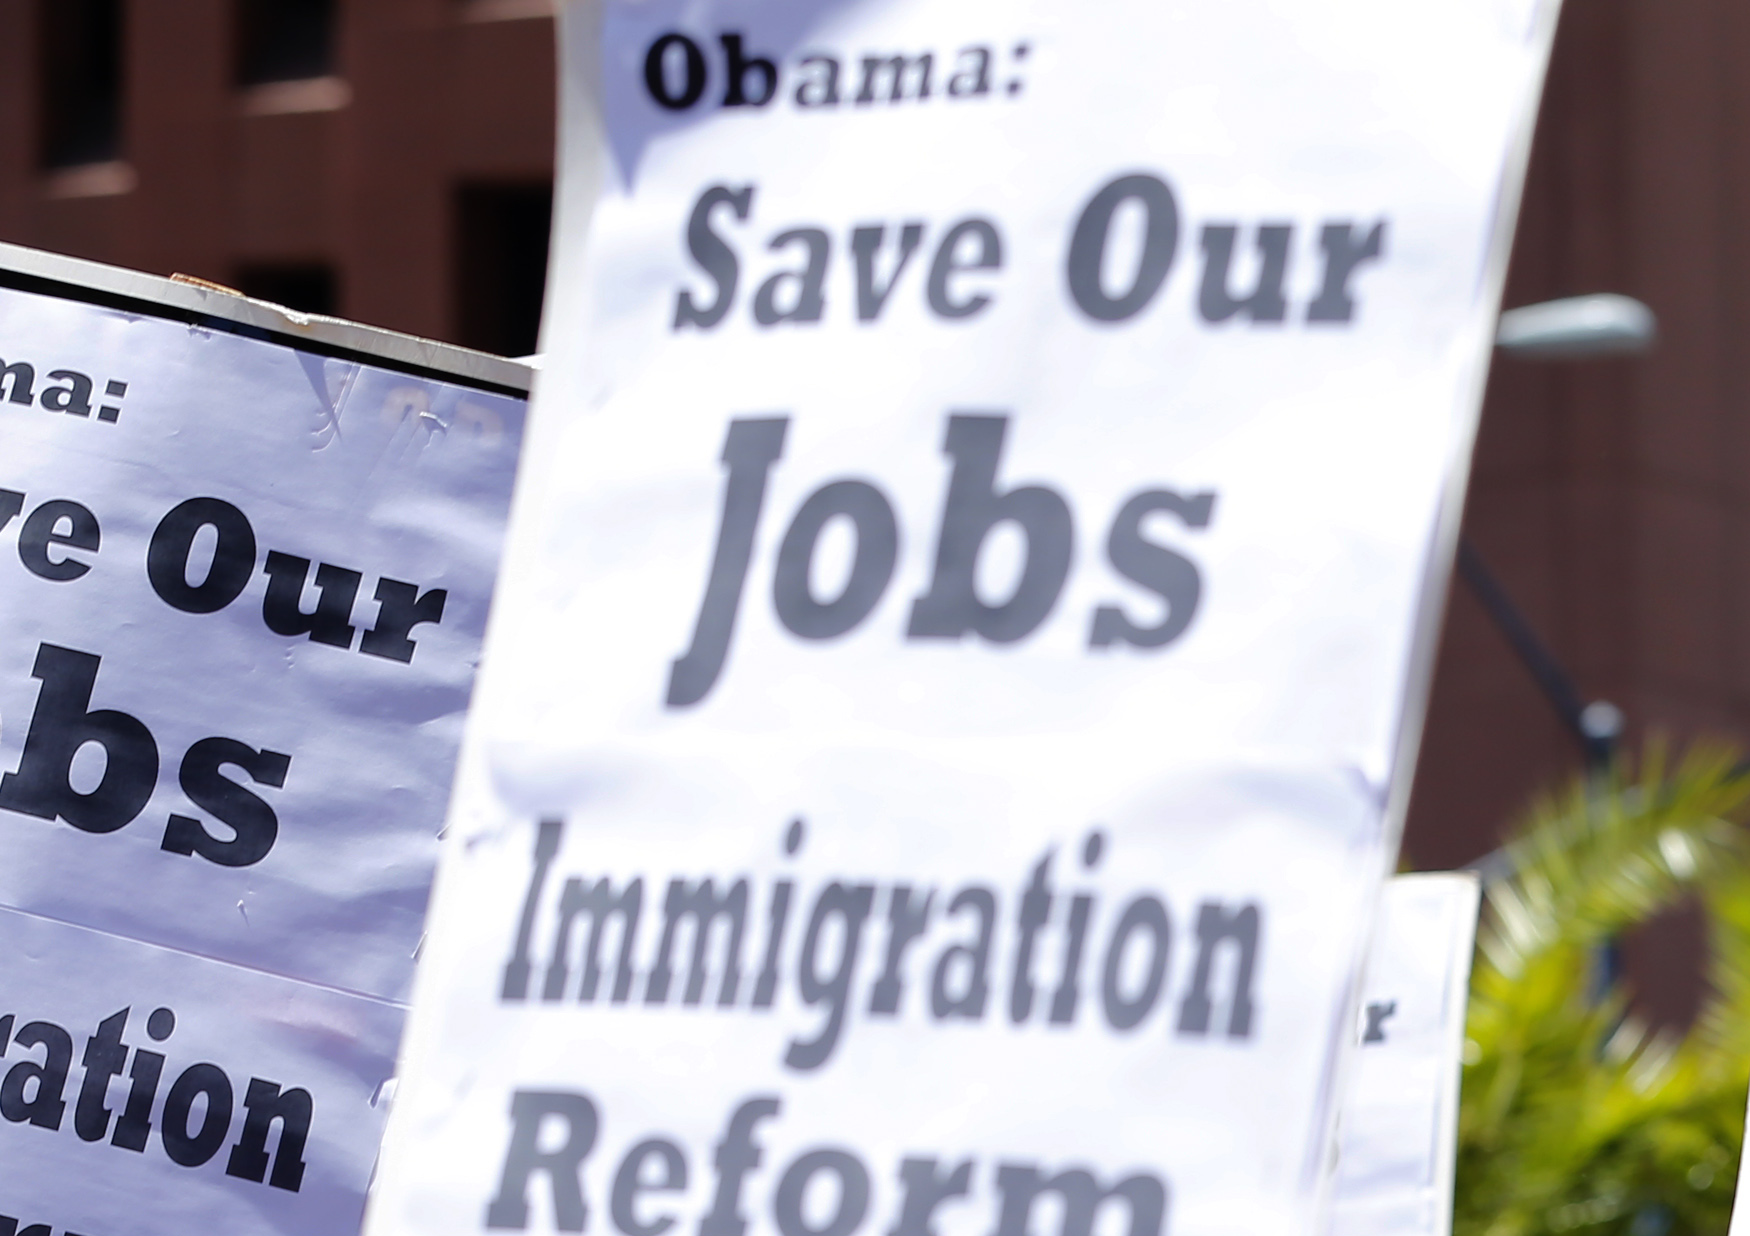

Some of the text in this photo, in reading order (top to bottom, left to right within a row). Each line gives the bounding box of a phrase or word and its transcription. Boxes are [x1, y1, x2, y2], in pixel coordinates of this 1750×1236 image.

[643, 32, 1033, 112] Obama:
[672, 172, 1389, 332] Save Our
[147, 496, 448, 664] Our
[665, 413, 1217, 709] Jobs
[501, 817, 1264, 1073] Immigration
[0, 1005, 315, 1194] ation
